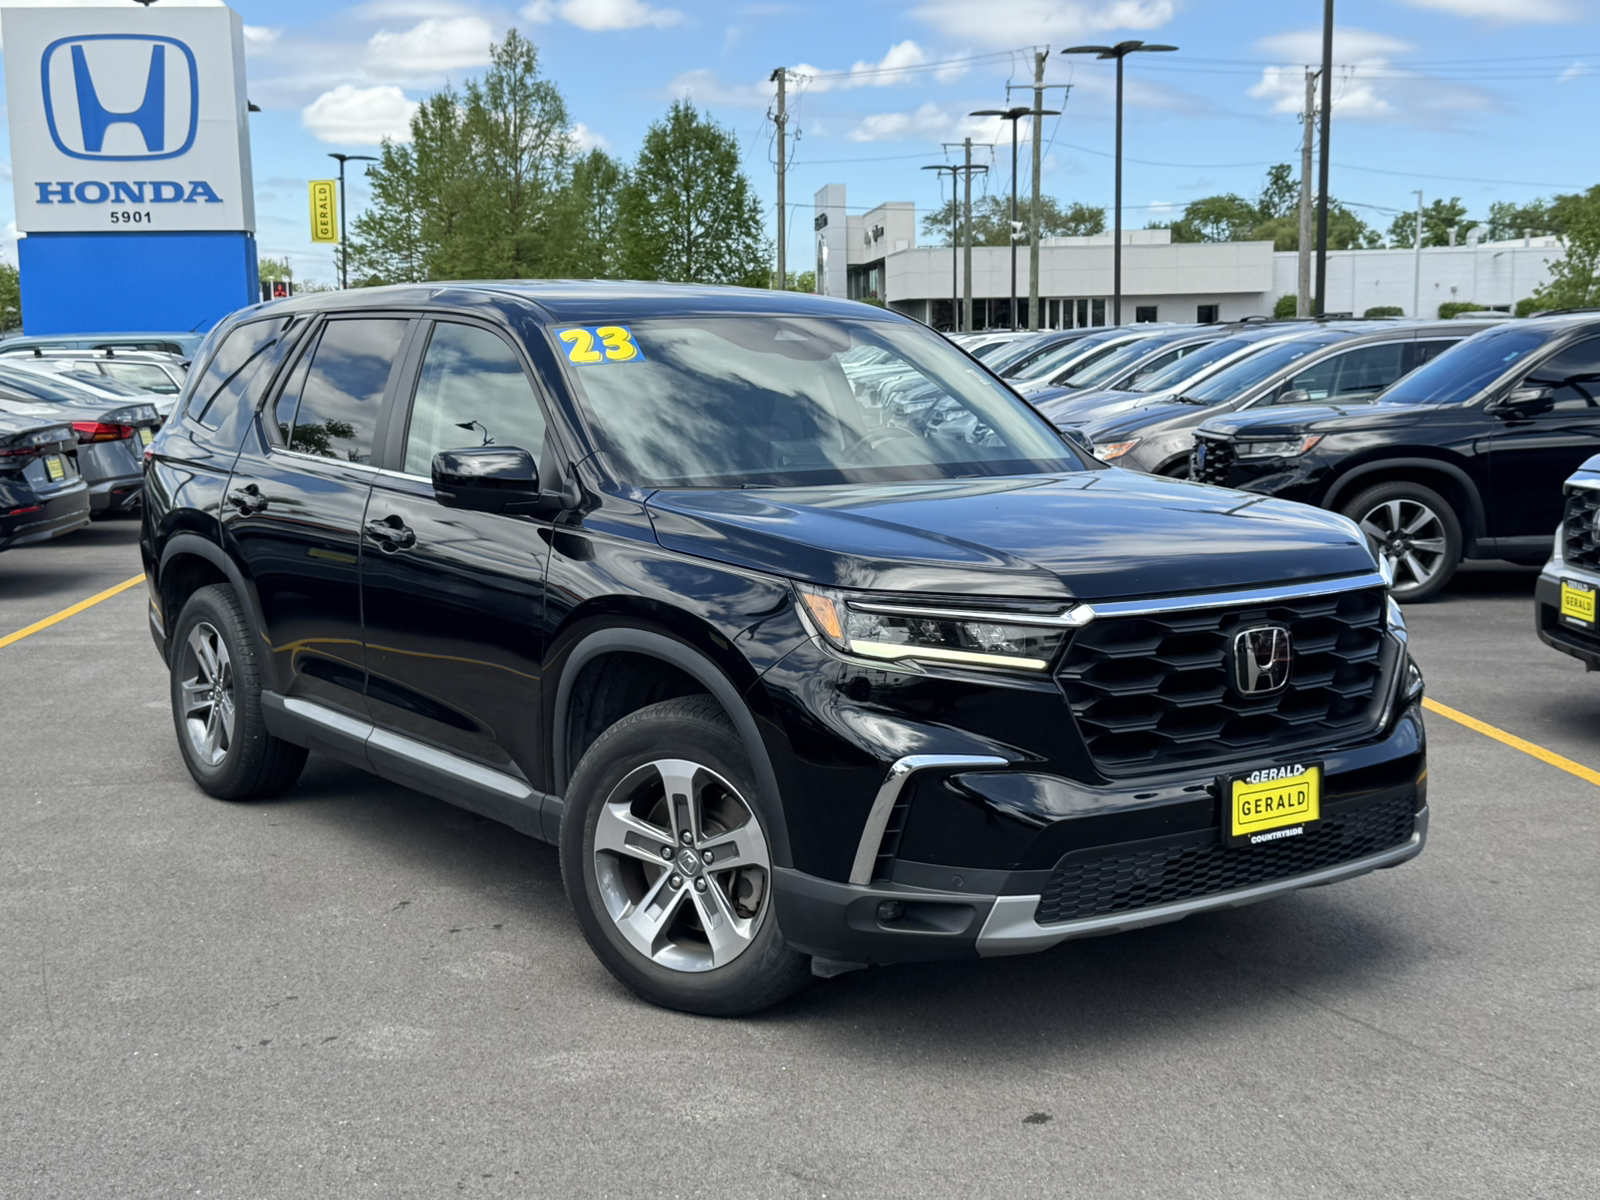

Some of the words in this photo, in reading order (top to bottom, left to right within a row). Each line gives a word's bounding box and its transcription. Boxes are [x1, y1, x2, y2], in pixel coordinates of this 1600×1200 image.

[34, 180, 224, 205] HONDA
[110, 211, 152, 224] 5901
[318, 187, 330, 236] GERALD
[559, 325, 638, 364] 23
[1565, 595, 1592, 612] GERALD
[1241, 790, 1306, 816] GERALD
[1250, 827, 1304, 845] COUNTRYSIDE
